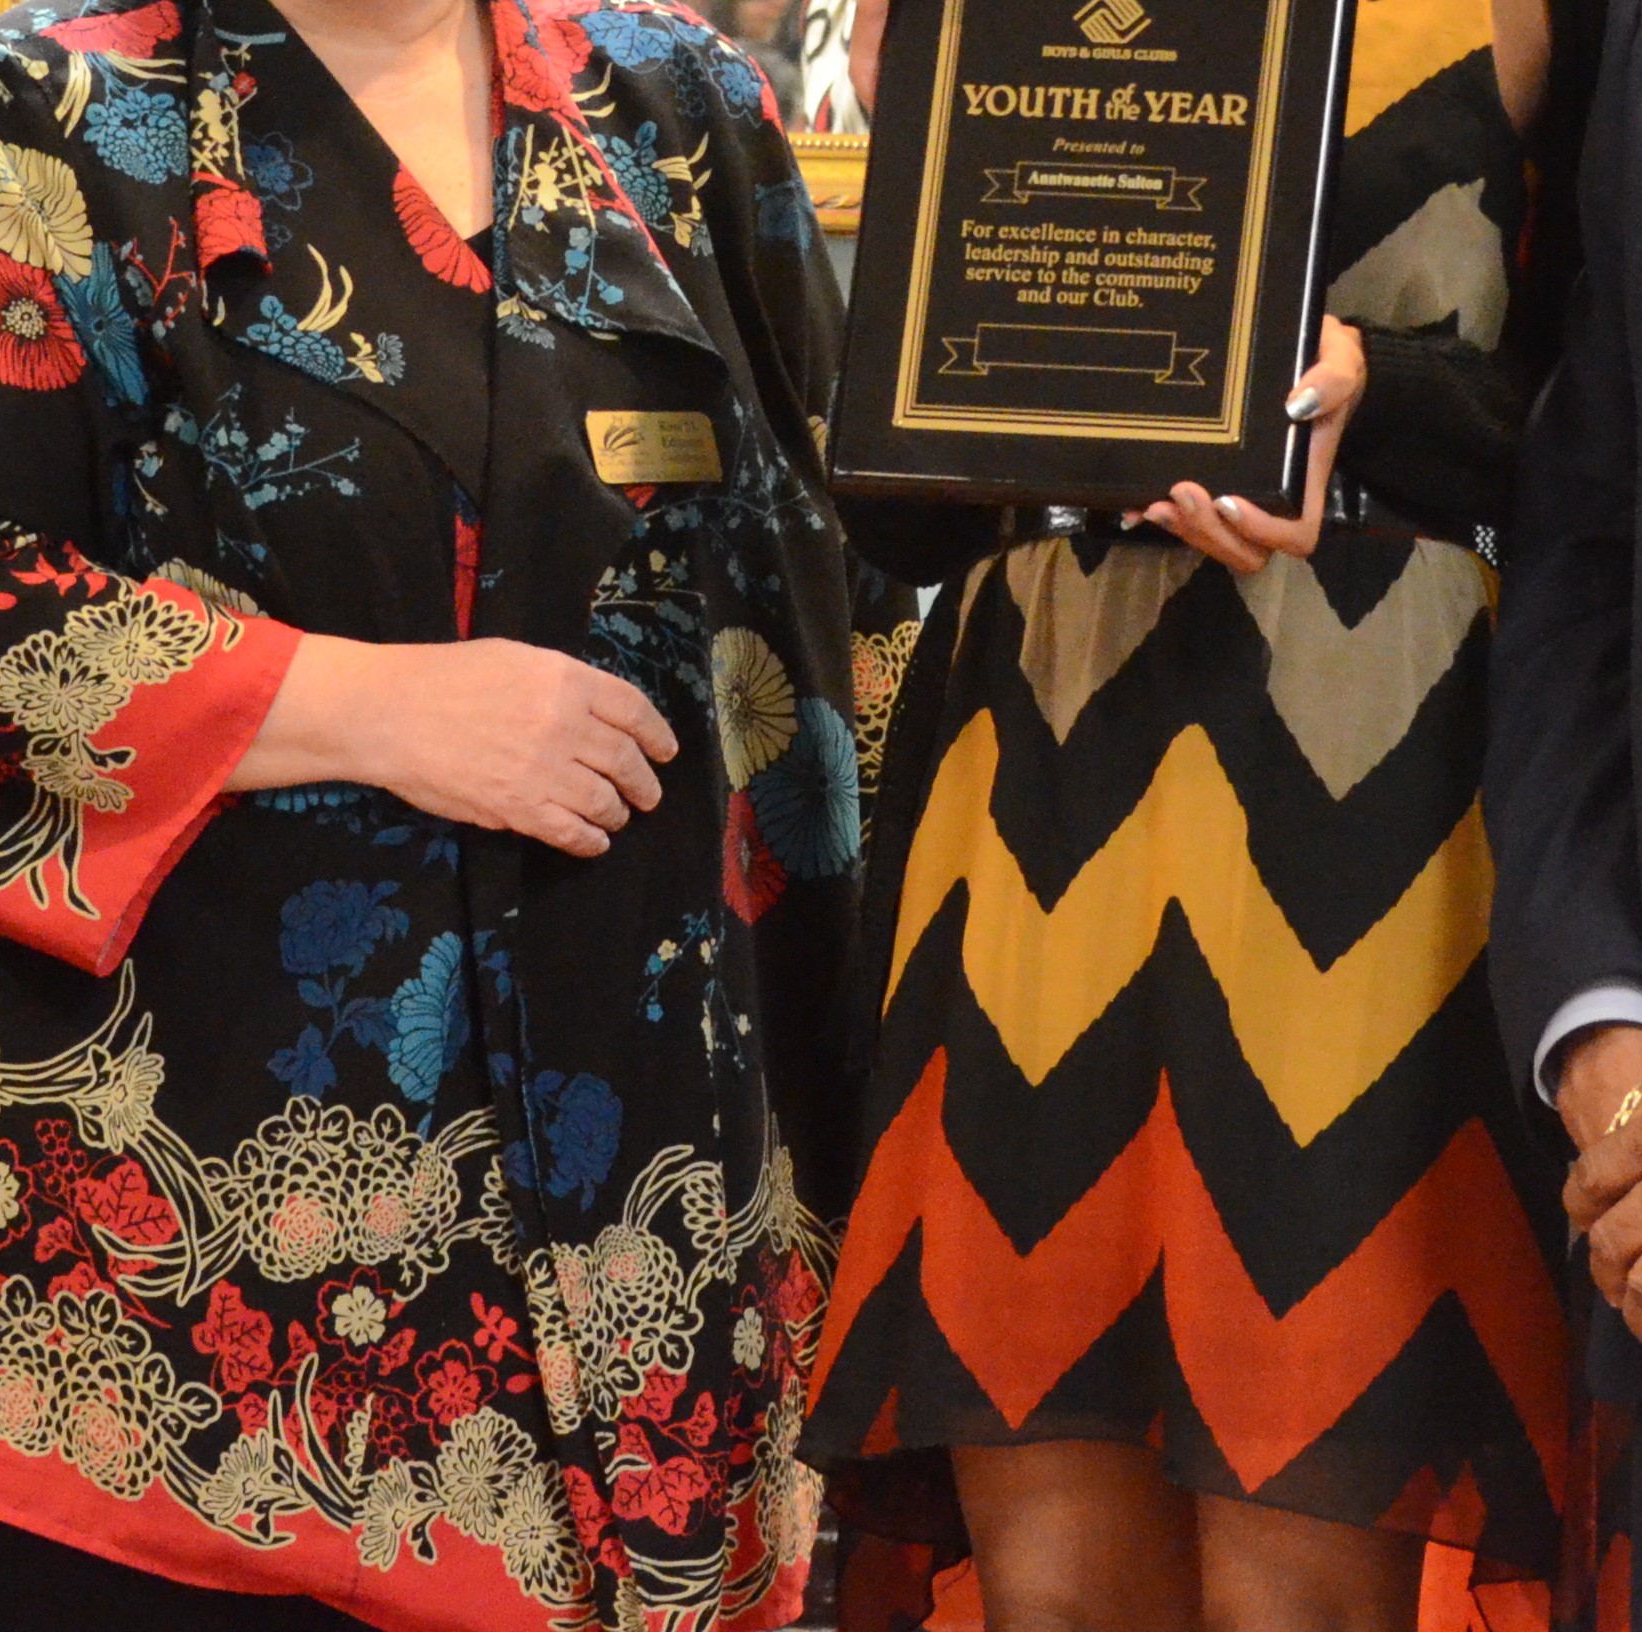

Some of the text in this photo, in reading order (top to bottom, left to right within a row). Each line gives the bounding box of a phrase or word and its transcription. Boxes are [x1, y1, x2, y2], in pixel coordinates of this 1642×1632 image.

[962, 83, 1249, 126] YOUTH of the YEAR
[1052, 137, 1145, 155] Presented to
[961, 219, 1216, 250] For excellence in character,
[965, 242, 1214, 275] leadership and outstanding
[965, 264, 1202, 295] service to the community
[1017, 286, 1143, 308] and our Club.
